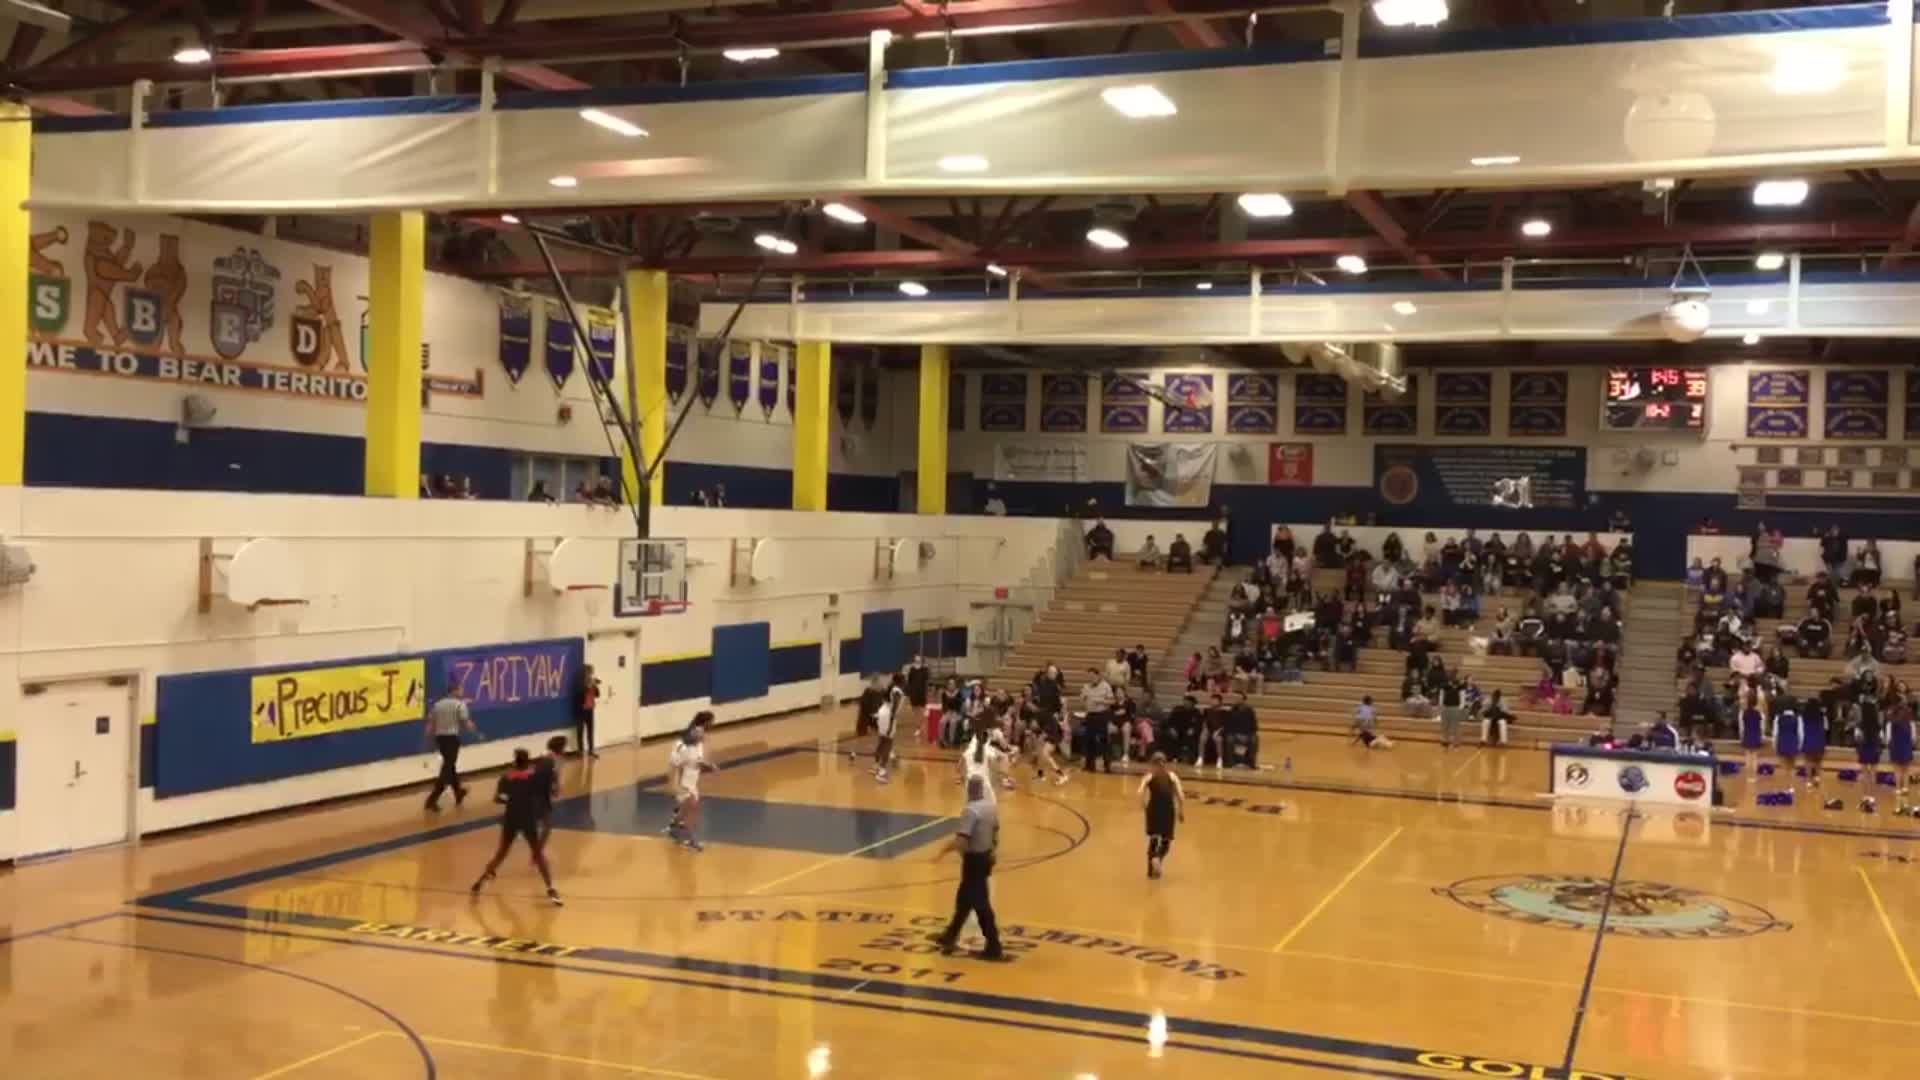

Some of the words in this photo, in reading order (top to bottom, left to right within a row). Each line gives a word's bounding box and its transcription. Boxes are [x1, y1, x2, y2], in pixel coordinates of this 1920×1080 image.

[34, 284, 61, 319] S
[130, 298, 156, 332] B
[218, 312, 241, 345] E
[296, 324, 317, 354] D
[95, 350, 140, 374] TO
[158, 357, 241, 386] BEAR
[276, 676, 369, 737] Precious
[376, 669, 400, 713] J
[695, 909, 895, 925] STATE
